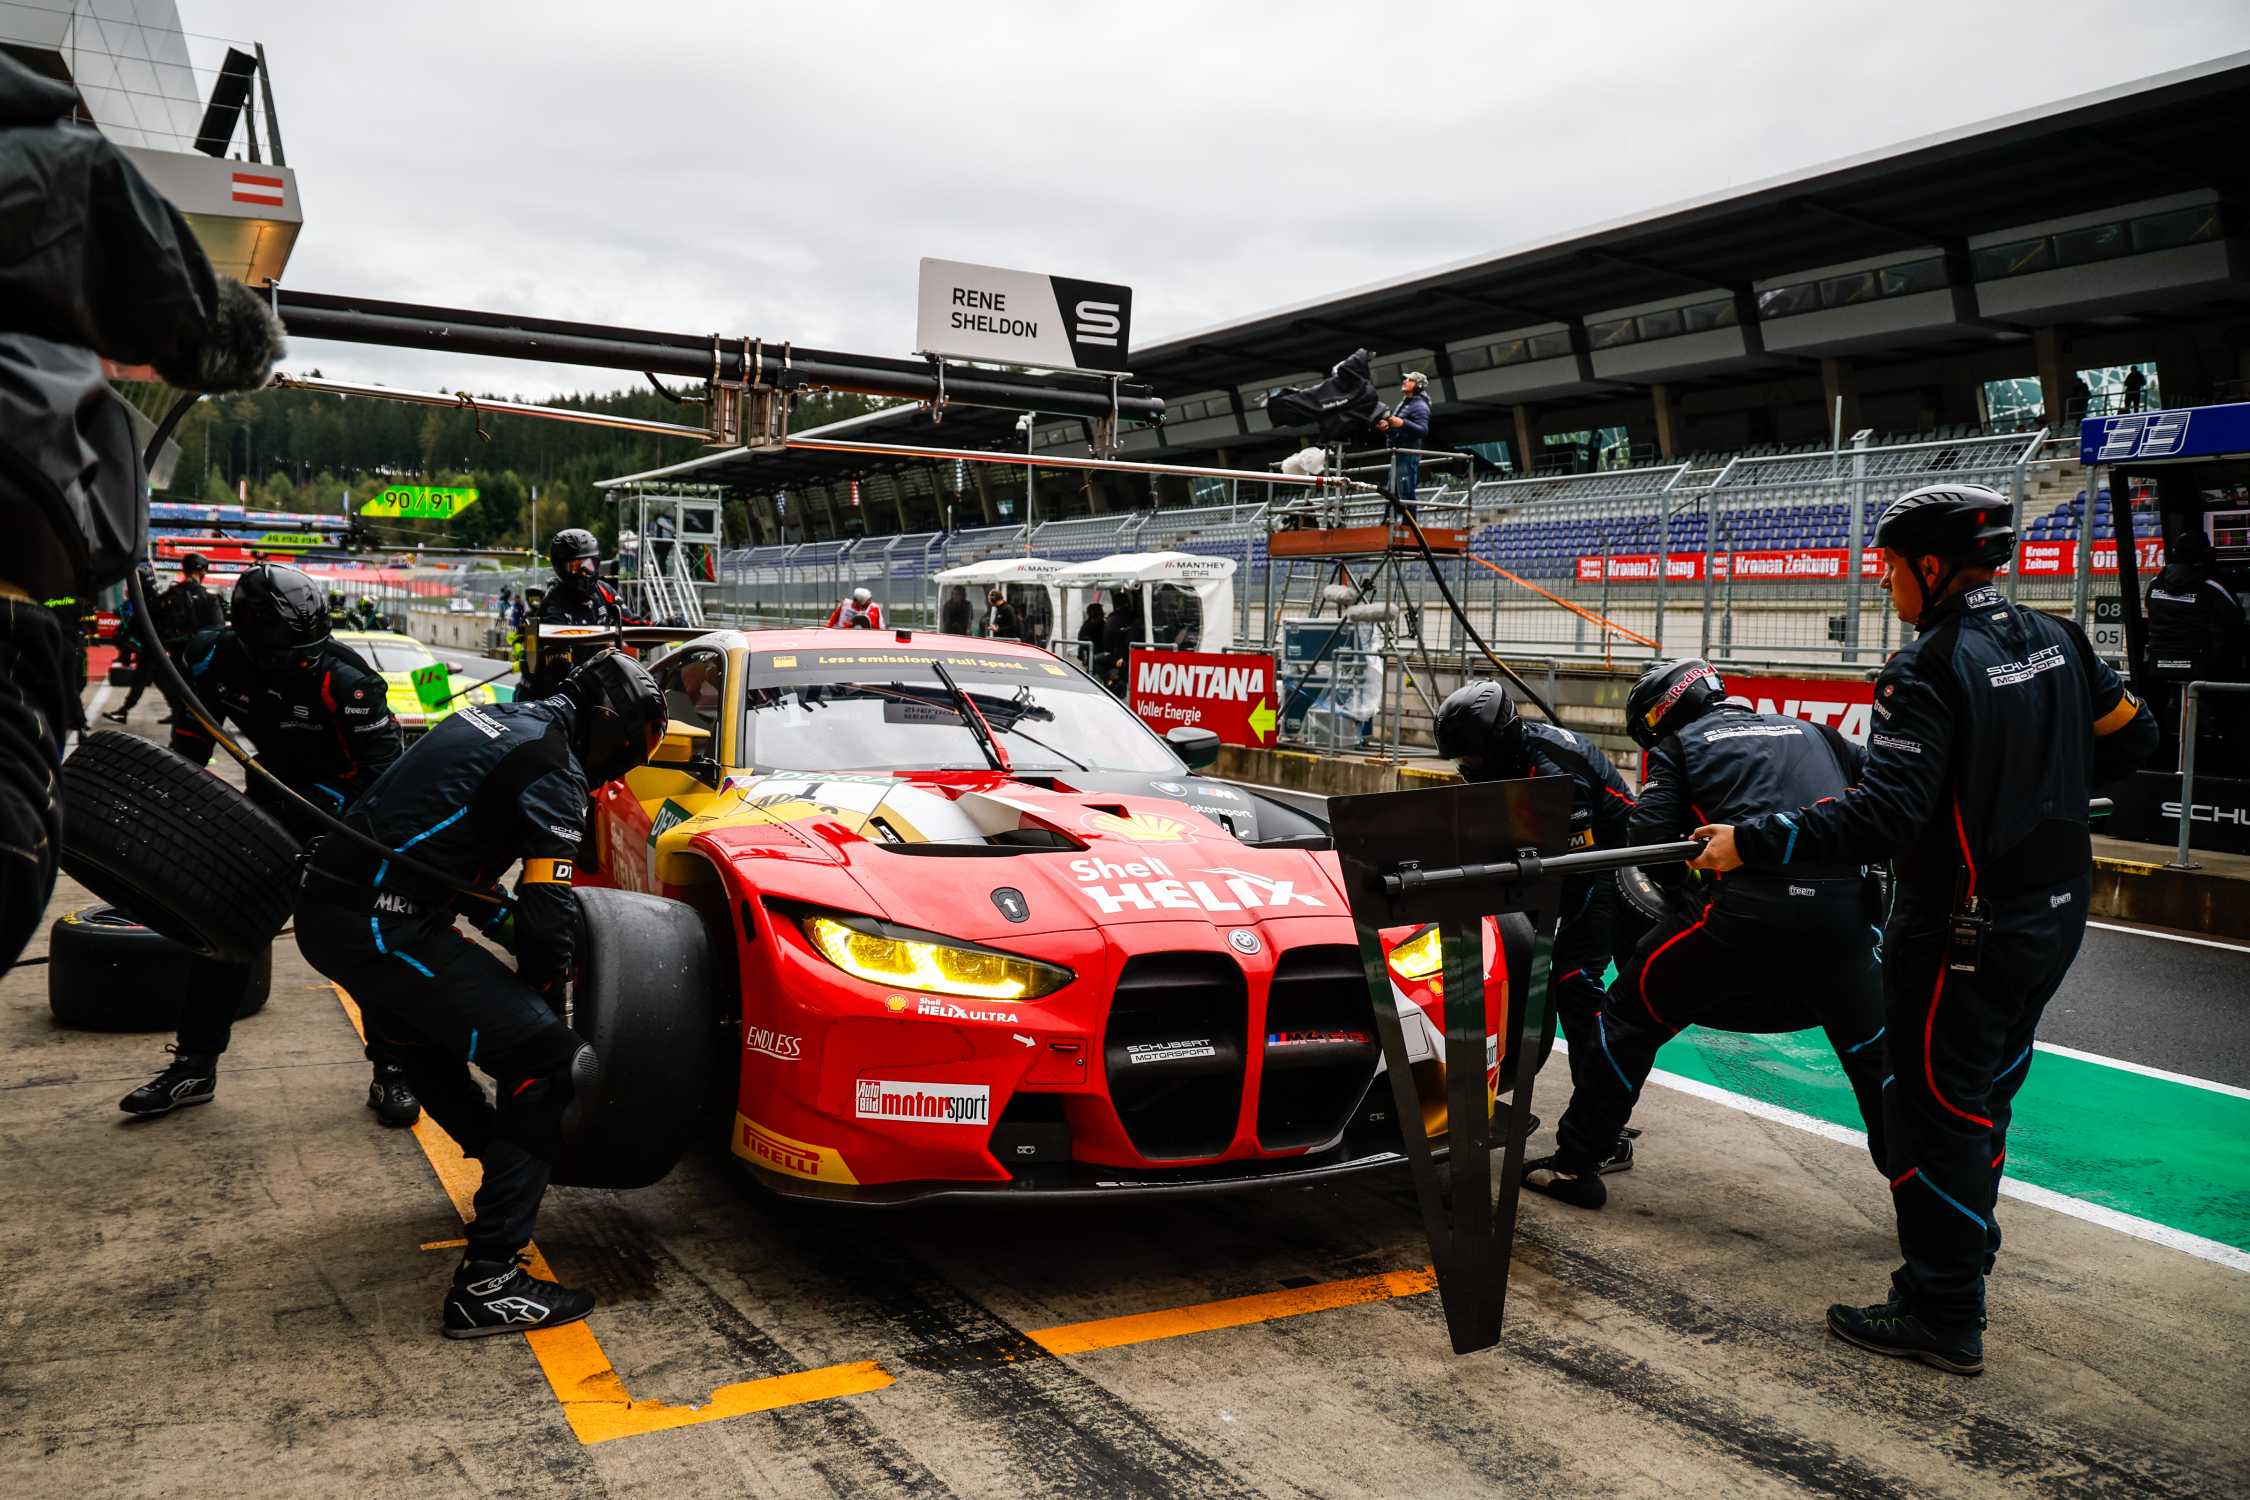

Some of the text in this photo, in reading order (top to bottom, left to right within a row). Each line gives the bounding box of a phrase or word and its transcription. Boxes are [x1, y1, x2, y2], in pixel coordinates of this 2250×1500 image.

[952, 287, 1006, 312] RENE
[951, 312, 1038, 338] SHELDON
[384, 491, 410, 509] 90
[430, 493, 455, 511] 91
[2025, 545, 2060, 557] Kronen
[1176, 560, 1226, 570] MANTHEY
[1608, 559, 1649, 577] Kronen
[1736, 555, 1783, 574] Kronen
[1784, 553, 1840, 576] Zeitung
[2025, 557, 2060, 571] Zeitung
[2097, 603, 2121, 617] 08
[2095, 630, 2120, 645] 05
[818, 655, 854, 664] Less
[947, 657, 977, 667] Full
[980, 659, 1029, 671] Speed.
[1137, 662, 1265, 702] MONTANA
[1137, 700, 1202, 726] Voller Energie
[1184, 802, 1253, 818] otorsport
[1070, 857, 1174, 882] Shell
[1080, 868, 1328, 914] HELIX
[919, 997, 941, 1006] Shell
[917, 1003, 1019, 1024] HELIX ULTRA
[746, 1025, 803, 1057] ENDLESS
[1126, 1039, 1211, 1053] SCHUBERT
[1133, 1047, 1213, 1063] MOTORSPORT
[857, 1082, 880, 1098] Auto
[859, 1097, 880, 1112] Bild
[743, 1122, 820, 1177] PIRELLI
